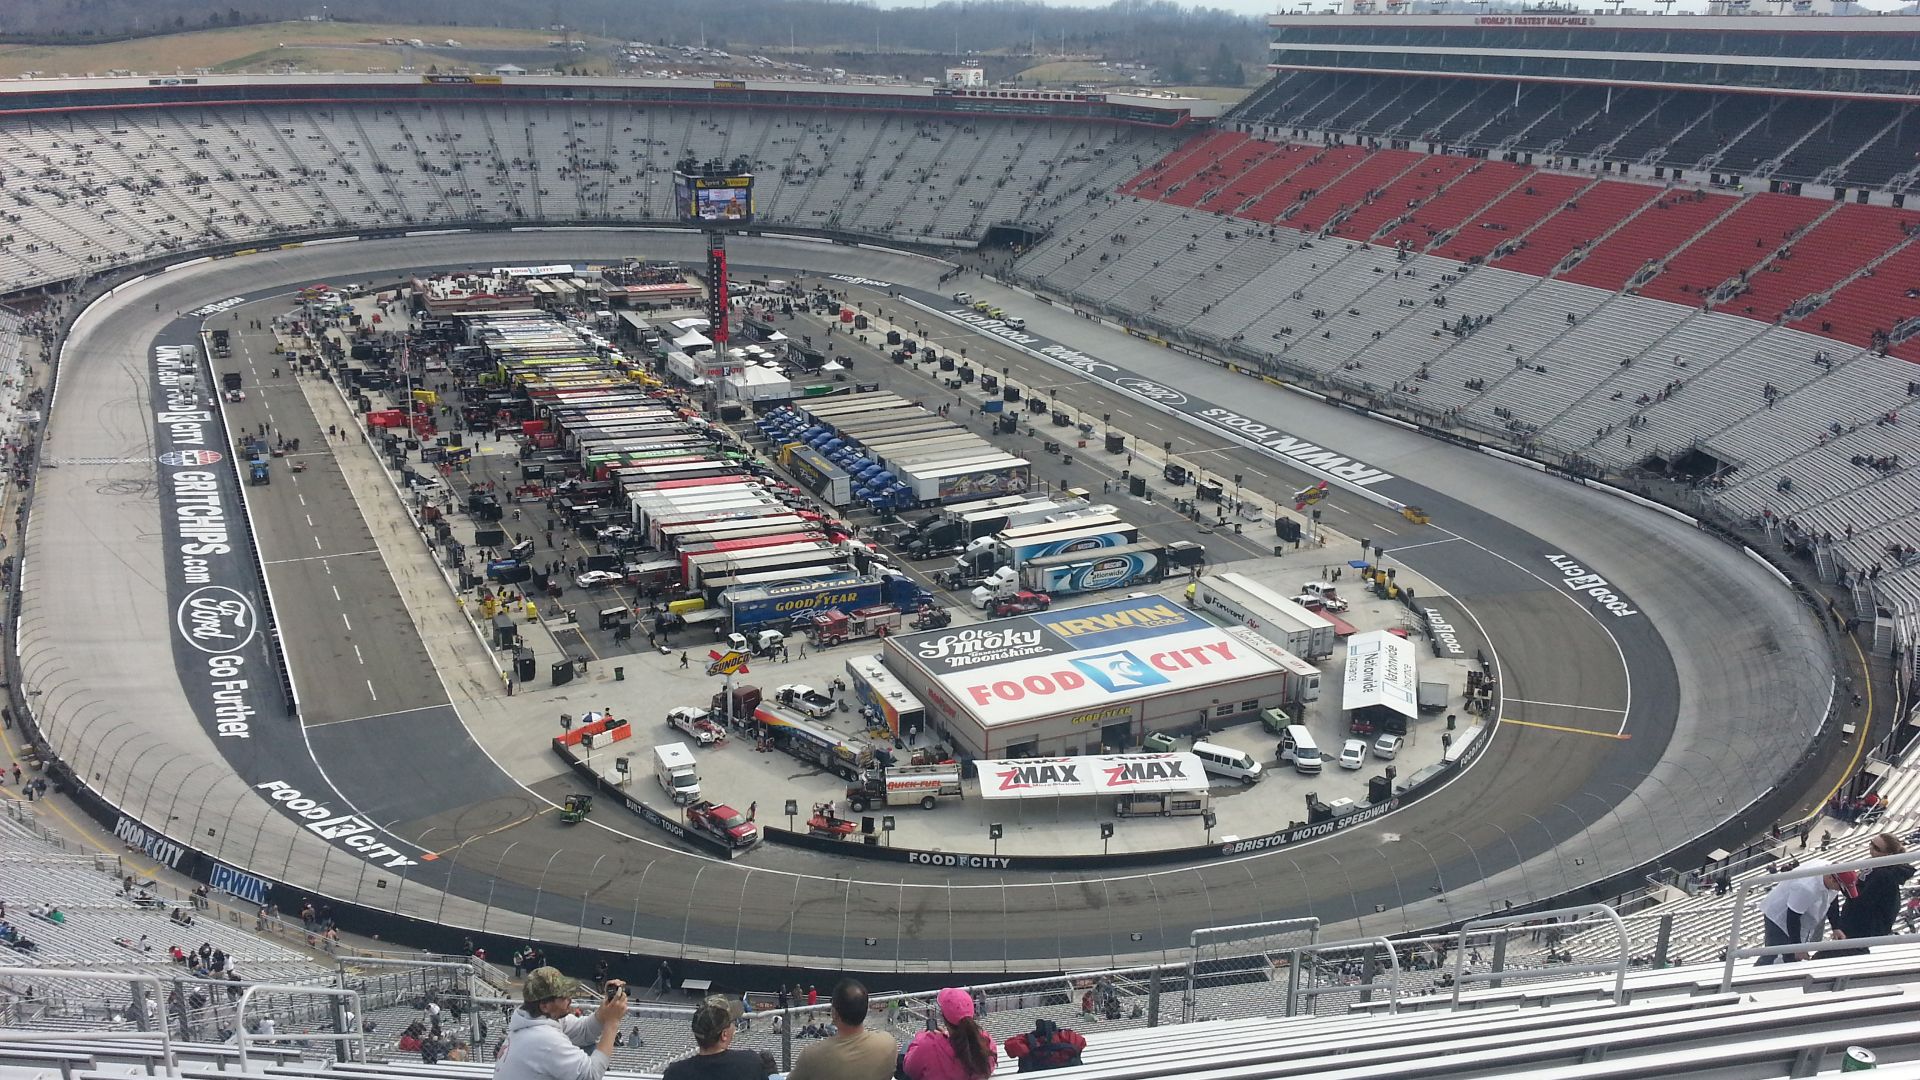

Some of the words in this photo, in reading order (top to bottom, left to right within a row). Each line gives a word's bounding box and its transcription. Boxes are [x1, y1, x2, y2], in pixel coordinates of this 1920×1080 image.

[1480, 17, 1512, 25] WORLD'S
[1514, 17, 1545, 25] FASTEST
[1547, 17, 1587, 25] HALF-MILE
[946, 309, 984, 325] CITY
[994, 328, 1039, 345] FOOD
[707, 368, 723, 376] FOOD
[1128, 380, 1181, 401] Ford
[170, 422, 204, 445] CITY
[1202, 408, 1279, 438] TOOLS
[1263, 435, 1395, 486] IRWIN
[173, 471, 230, 584] GRITCHIPS.com
[1544, 554, 1586, 577] CITY
[770, 579, 857, 594] GOODYEAR
[775, 592, 858, 612] GOODYEAR
[1211, 596, 1245, 622] Forward
[1246, 618, 1260, 630] Air
[1588, 587, 1638, 617] FOOD
[189, 598, 246, 640] Ford
[1047, 604, 1179, 637] IRWIN
[1142, 616, 1187, 628] TOOLS
[1424, 607, 1445, 625] CITY
[918, 629, 1041, 659] Smoky
[959, 629, 1001, 642] Ole
[1440, 632, 1465, 654] FOOD
[208, 655, 244, 678] Go
[711, 653, 751, 673] SUNOCO
[945, 645, 1053, 668] Moonshine
[1384, 645, 1399, 684] Nationwide
[967, 671, 1085, 706] FOOD
[1150, 641, 1236, 672] CITY
[1363, 652, 1379, 694] Nationwide
[211, 679, 256, 739] Further
[1072, 706, 1135, 725] GOODYEAR
[995, 764, 1081, 791] ZMAX
[1103, 760, 1188, 787] ZMAX
[256, 780, 331, 820] FOOD
[344, 835, 419, 868] CITY
[626, 799, 641, 814] BUILT
[661, 819, 684, 837] TOUGH
[1234, 833, 1287, 853] BRISTOL
[1291, 821, 1335, 842] MOTOR
[1337, 801, 1391, 829] SPEEDWAY
[113, 816, 145, 848] FOOD
[152, 838, 185, 869] CITY
[909, 852, 956, 866] FOOD
[970, 857, 1011, 869] CITY
[210, 863, 268, 905] IRWIN
